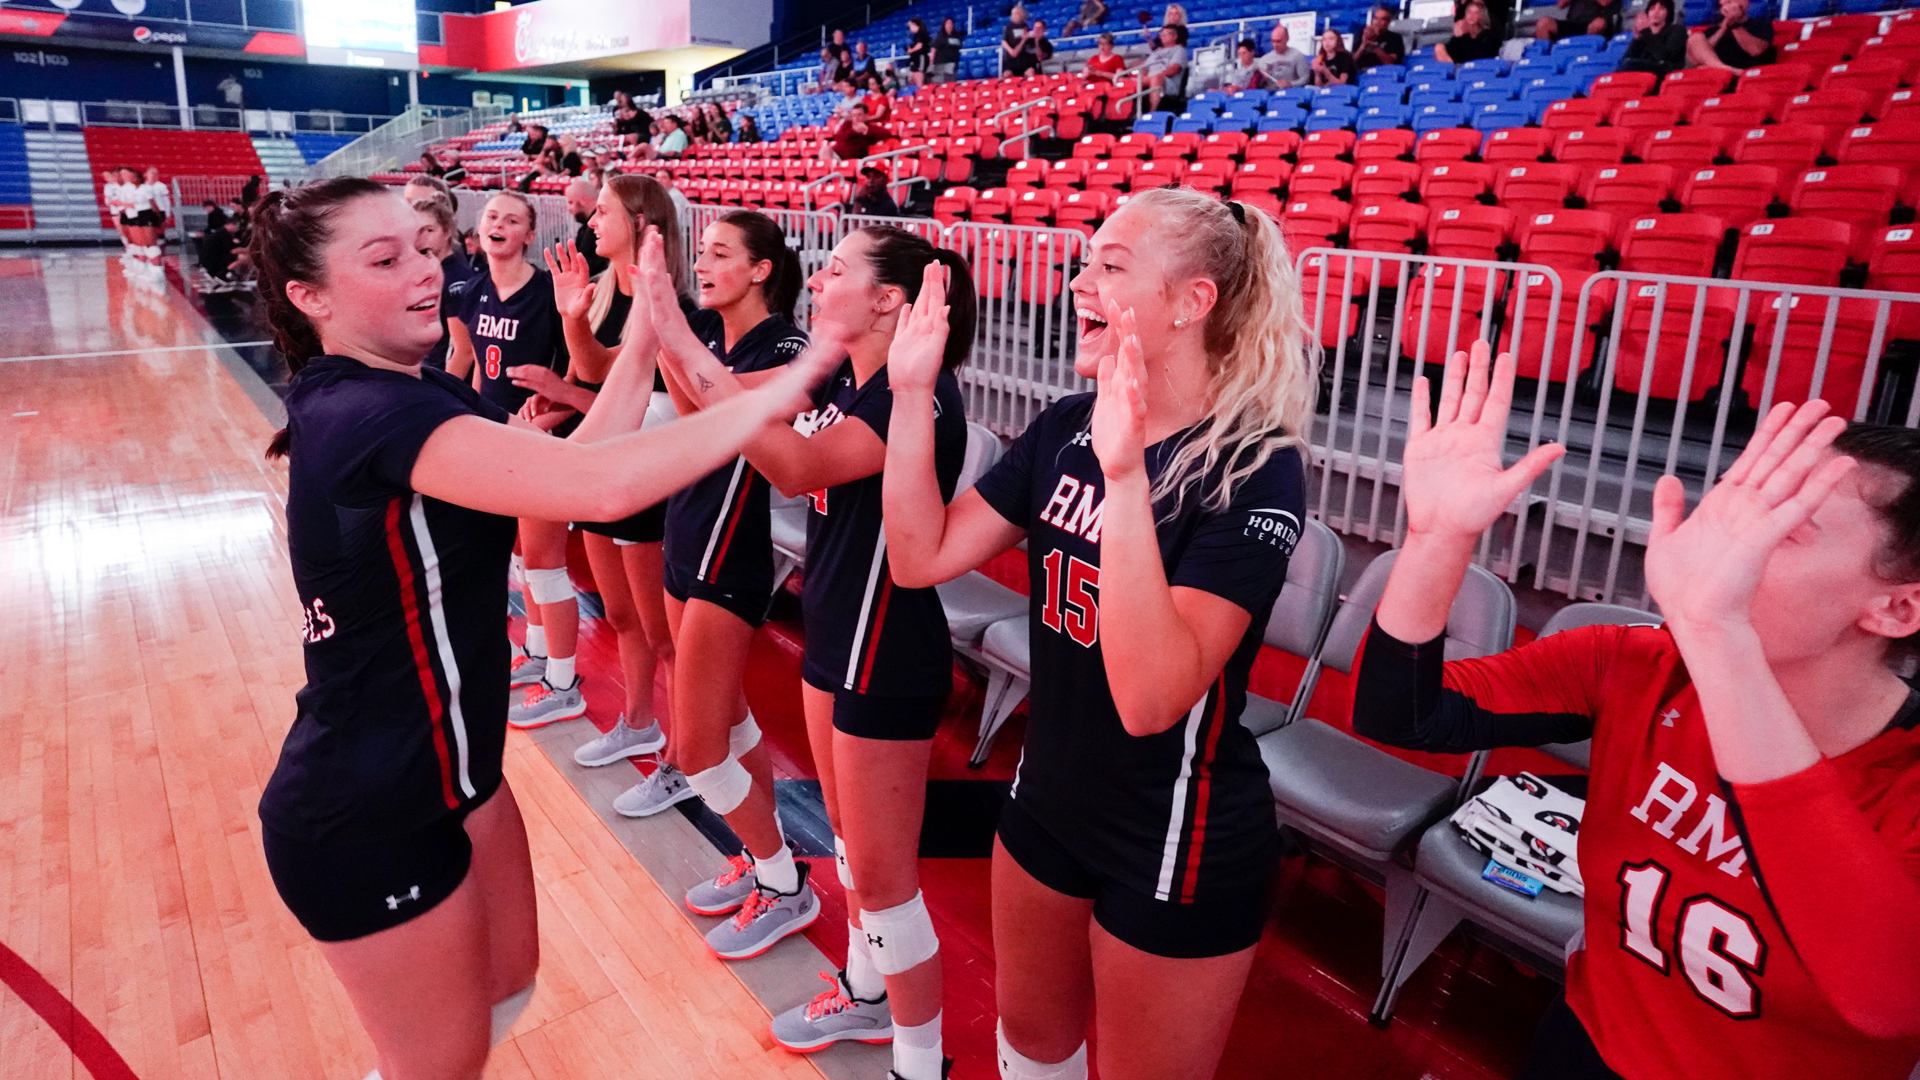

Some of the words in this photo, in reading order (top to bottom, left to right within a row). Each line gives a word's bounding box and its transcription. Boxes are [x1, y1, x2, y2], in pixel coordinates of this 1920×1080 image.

[151, 31, 187, 44] pepsi
[476, 314, 520, 341] RMU
[485, 344, 502, 380] 8
[1039, 473, 1106, 544] RM
[1247, 515, 1299, 549] HORIZO
[1042, 547, 1101, 648] 15
[1629, 761, 1759, 889] RM
[1616, 857, 1769, 1022] 16
